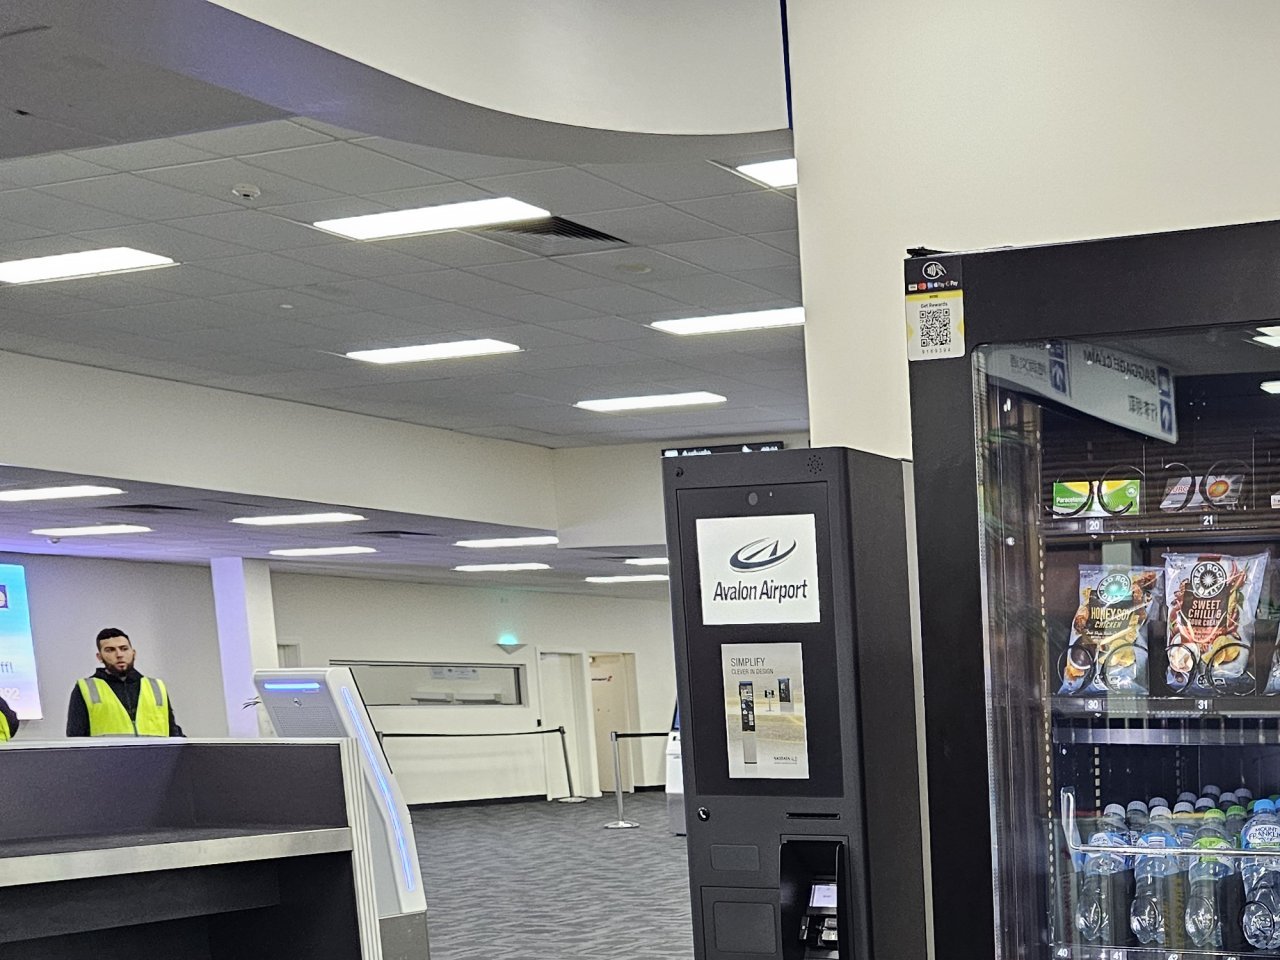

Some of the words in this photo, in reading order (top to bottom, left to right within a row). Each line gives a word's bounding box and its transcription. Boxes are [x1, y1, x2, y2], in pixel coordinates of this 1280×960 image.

[1202, 514, 1213, 526] 21
[1089, 520, 1100, 531] 20
[713, 580, 758, 602] Avalon
[759, 578, 808, 605] Airport
[1192, 600, 1221, 610] SWEET
[1188, 609, 1215, 618] CHILLI
[730, 657, 766, 667] SIMPLIFY
[1088, 700, 1099, 709] 30
[1198, 699, 1208, 709] 31
[1254, 825, 1278, 834] MOUNT
[1056, 948, 1069, 957] 40
[1113, 951, 1124, 960] 41
